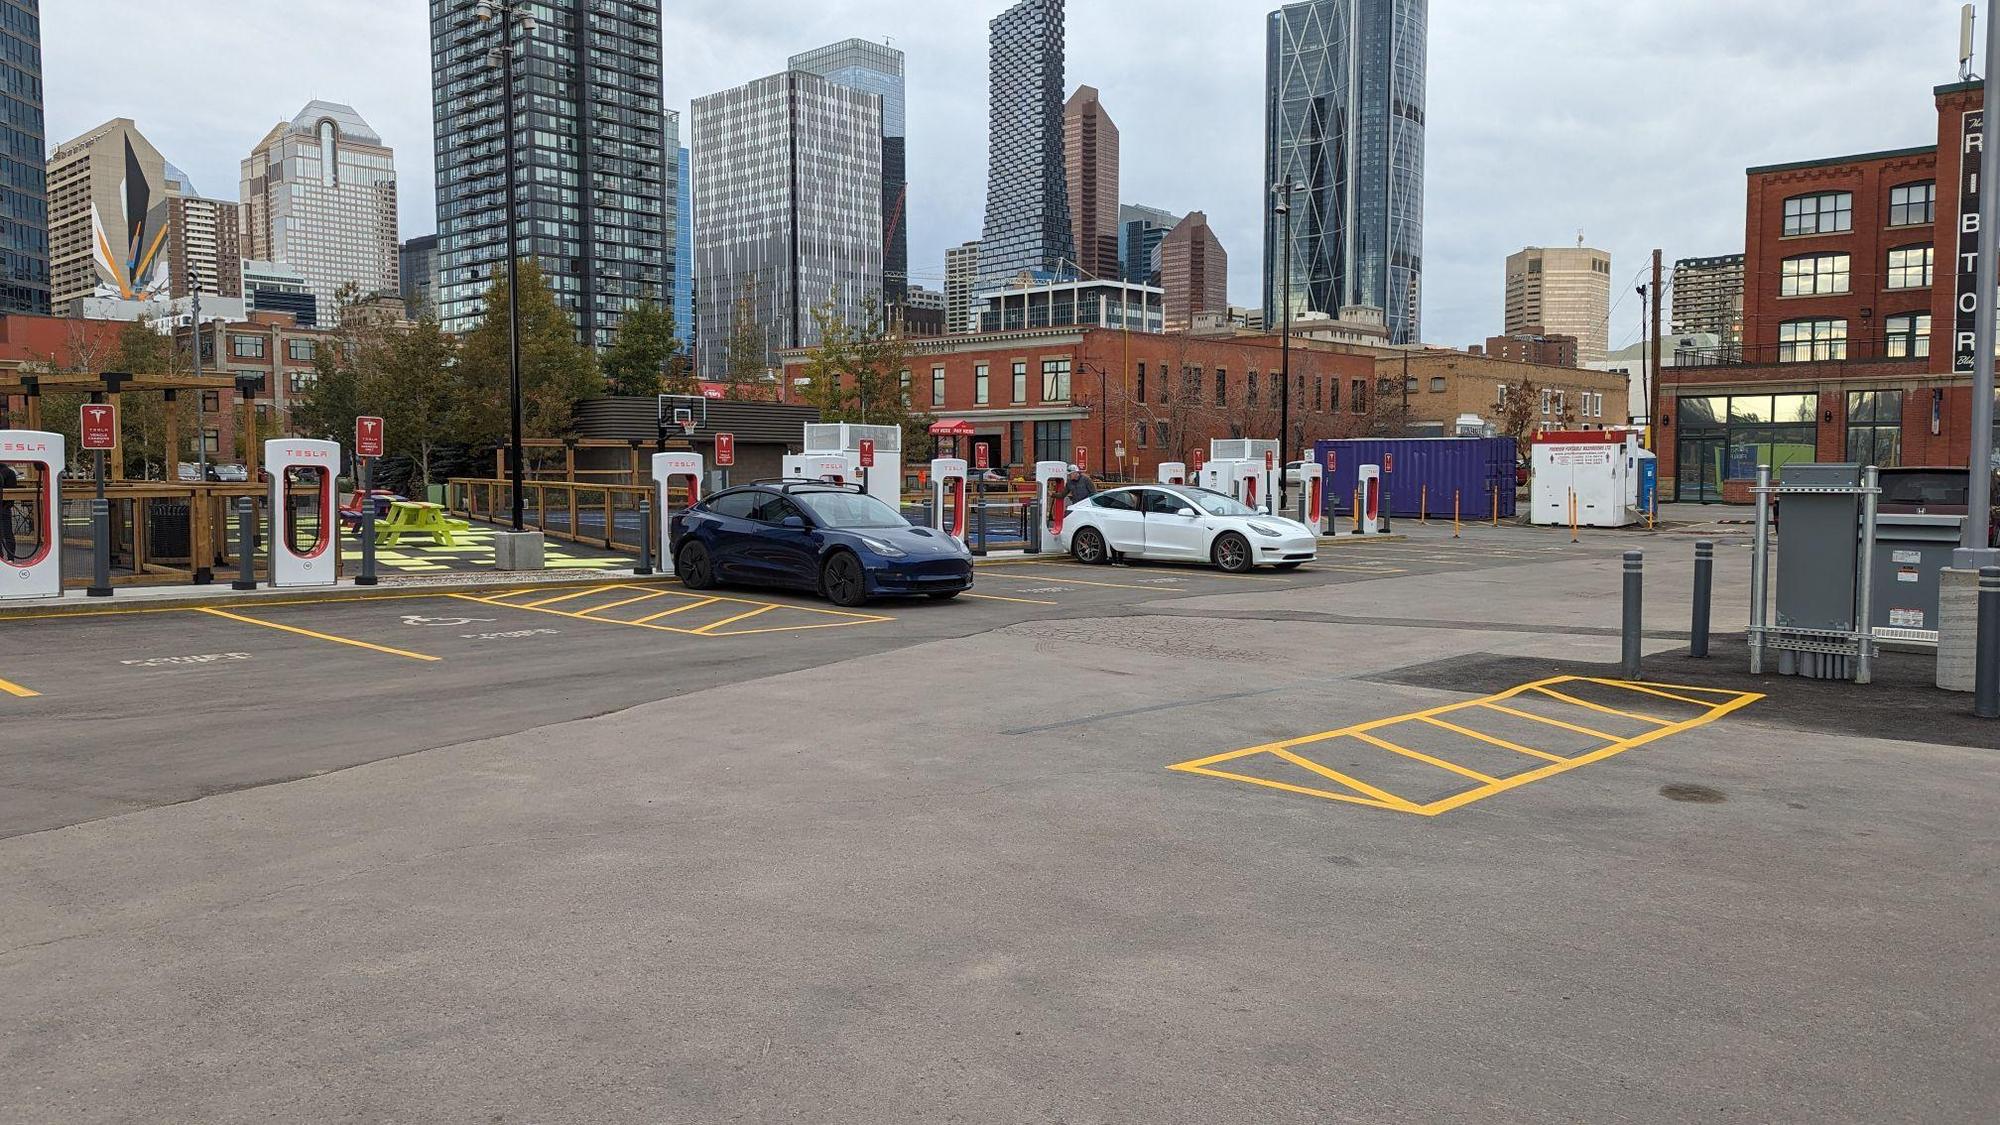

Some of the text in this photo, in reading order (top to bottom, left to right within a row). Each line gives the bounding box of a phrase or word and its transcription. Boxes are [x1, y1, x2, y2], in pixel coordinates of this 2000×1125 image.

[1968, 118, 1984, 129] The
[1957, 132, 1984, 352] RIBTOR
[4, 443, 46, 451] ESLA
[286, 449, 329, 458] TESLA
